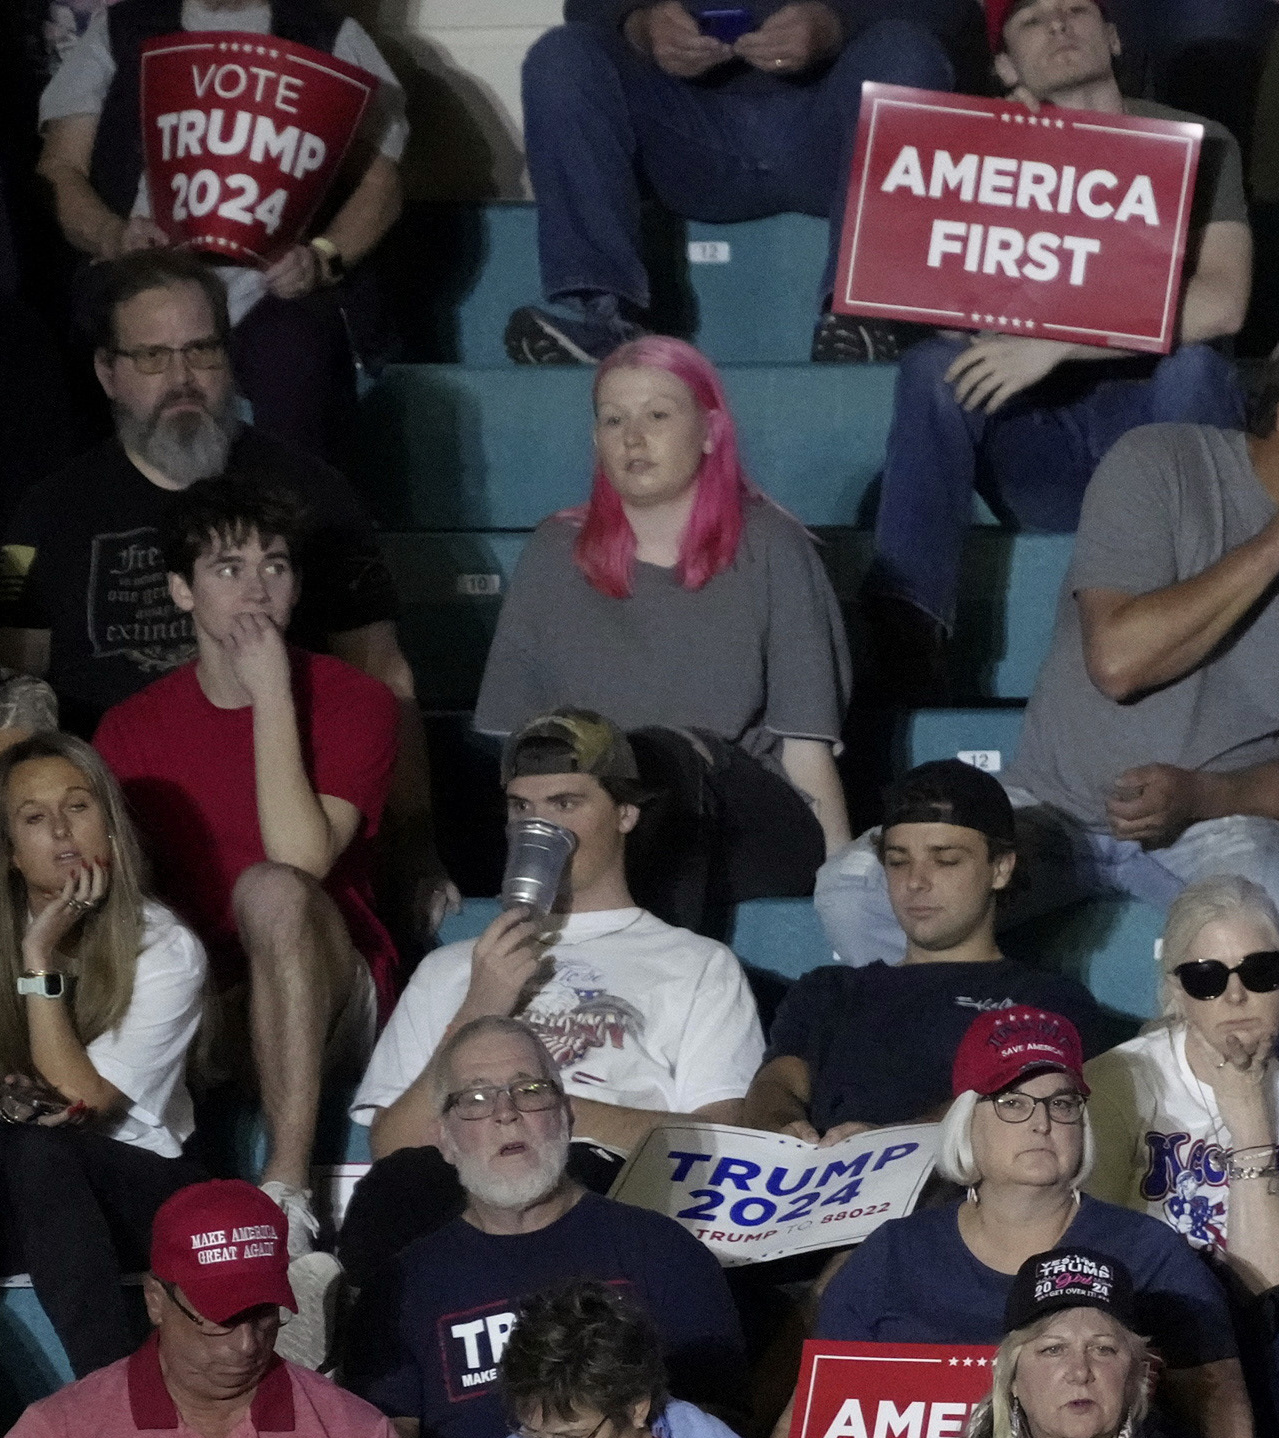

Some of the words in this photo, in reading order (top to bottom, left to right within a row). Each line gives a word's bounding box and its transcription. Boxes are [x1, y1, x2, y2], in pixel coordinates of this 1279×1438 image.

[192, 62, 305, 113] VOTE
[156, 109, 327, 180] TRUMP
[171, 172, 290, 234] 2024
[881, 146, 1160, 227] AMERICA
[926, 219, 1101, 286] FIRST
[1000, 1045, 1025, 1058] SAVE
[667, 1140, 920, 1199] TRUMP
[676, 1176, 866, 1228] 2024
[694, 1226, 779, 1246] TRUMP
[784, 1218, 816, 1236] TO
[820, 1201, 891, 1225] 88022
[190, 1229, 227, 1250] MAKE
[231, 1224, 278, 1243] AMERICA
[197, 1246, 238, 1265] GREAT
[243, 1241, 275, 1259] AGAIN
[1034, 1281, 1052, 1298] 20
[1092, 1282, 1109, 1296] 24
[1040, 1263, 1110, 1278] TRUMP
[1049, 1288, 1064, 1297] GET
[1065, 1287, 1084, 1296] OVER
[461, 1368, 498, 1387] MAKE
